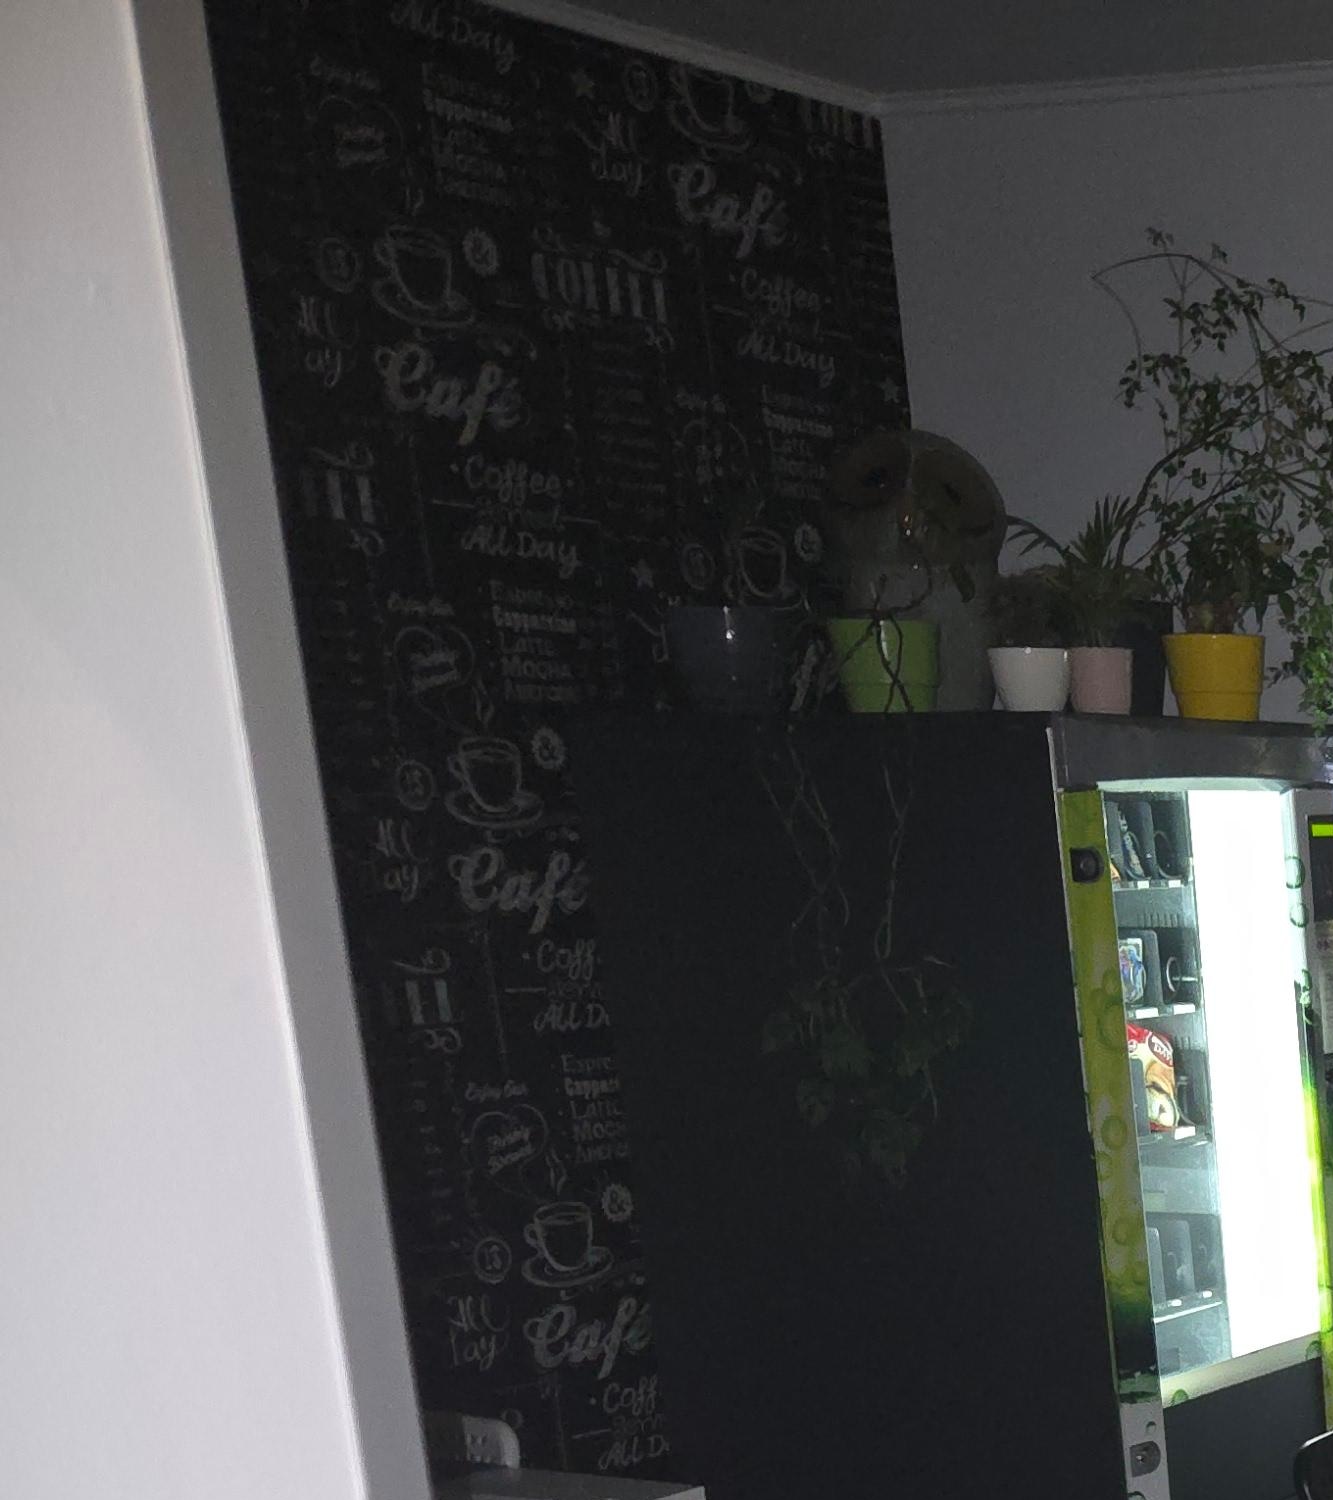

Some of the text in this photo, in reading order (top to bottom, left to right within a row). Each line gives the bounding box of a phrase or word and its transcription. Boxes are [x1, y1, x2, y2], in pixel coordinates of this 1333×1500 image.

[374, 342, 524, 447] Café
[464, 455, 563, 506] Coffee
[449, 846, 592, 934] Café
